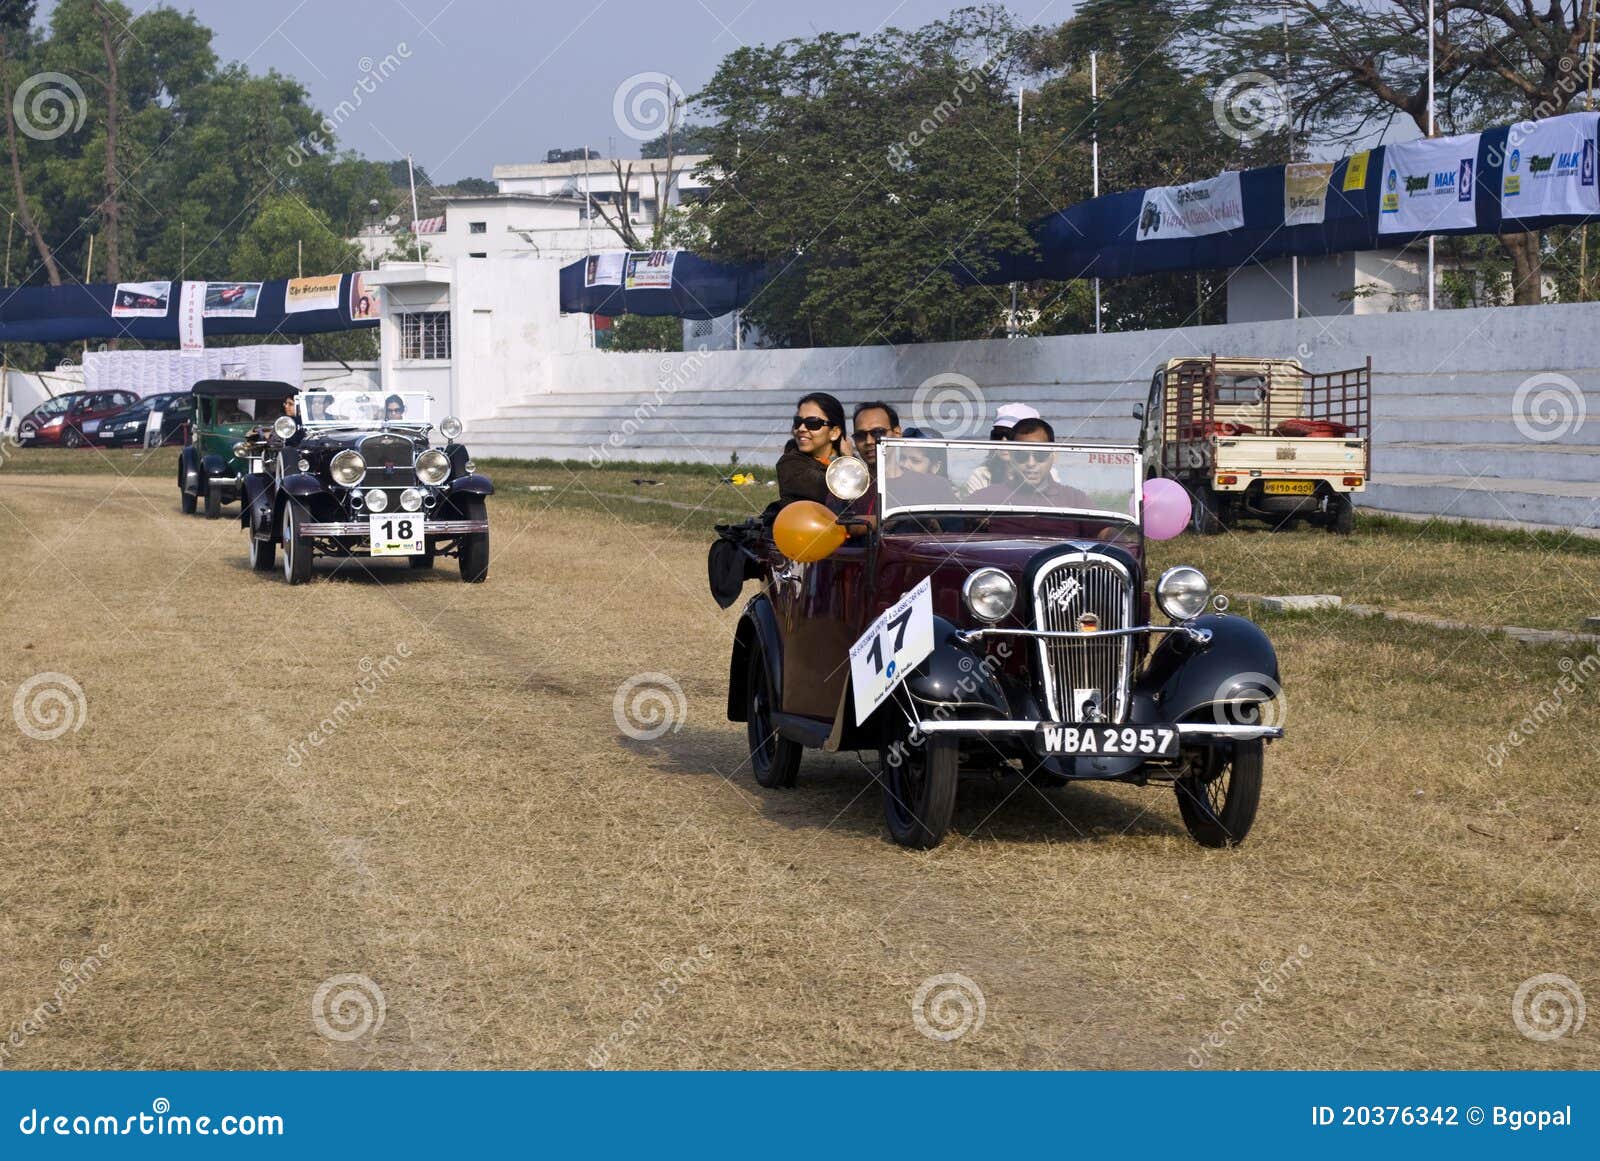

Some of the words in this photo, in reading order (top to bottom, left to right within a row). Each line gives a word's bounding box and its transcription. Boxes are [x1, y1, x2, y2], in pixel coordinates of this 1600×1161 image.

[1434, 171, 1456, 187] MAK
[1088, 452, 1130, 464] PRESS
[381, 520, 413, 540] 18
[867, 606, 912, 675] 17
[1043, 727, 1098, 753] WBA
[1103, 727, 1174, 754] 2957
